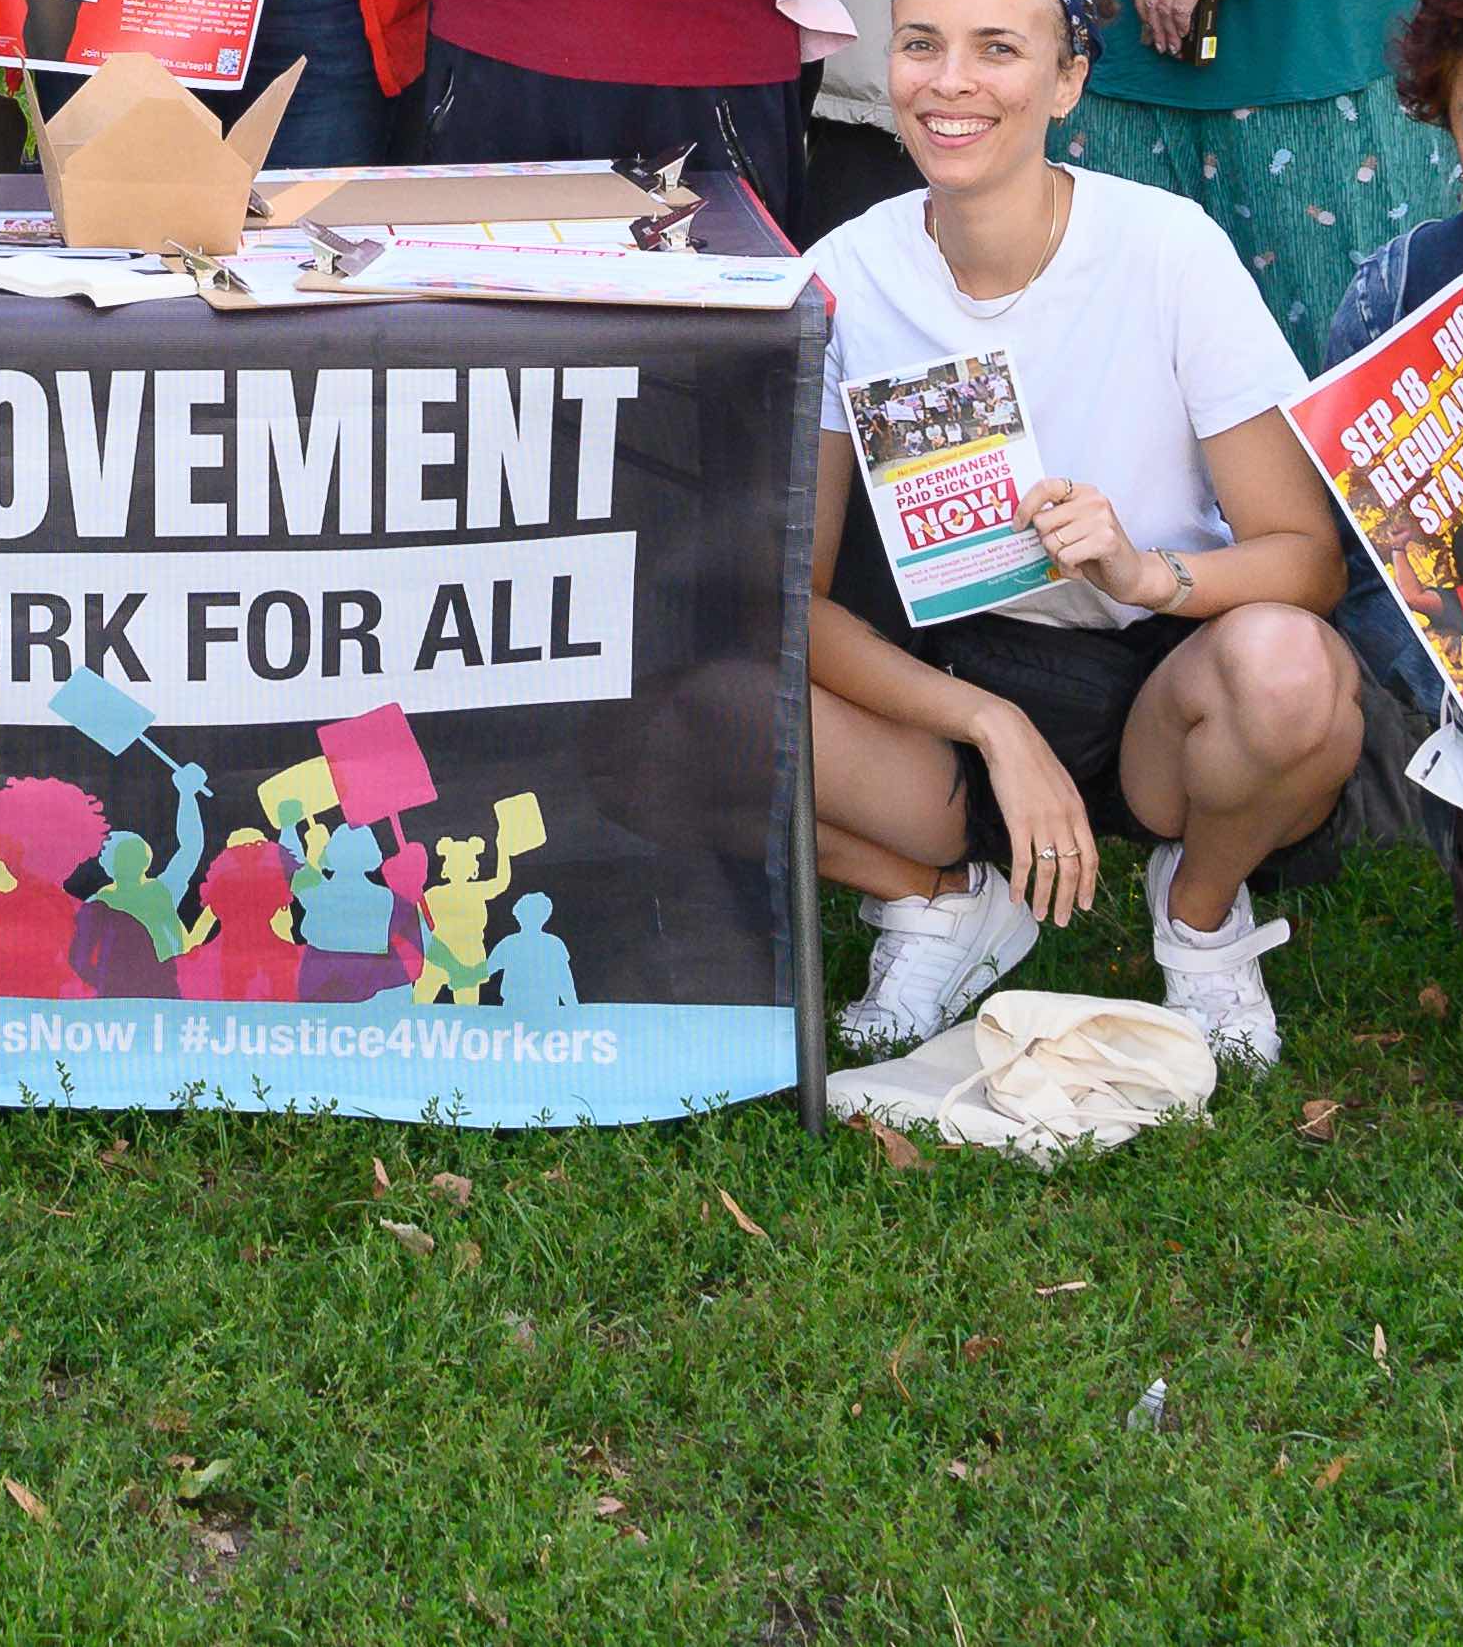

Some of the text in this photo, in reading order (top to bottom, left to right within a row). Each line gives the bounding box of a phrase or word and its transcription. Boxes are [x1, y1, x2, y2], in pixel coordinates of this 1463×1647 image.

[1340, 395, 1396, 469] SEP
[1390, 363, 1428, 413] 18
[894, 482, 912, 496] 10
[916, 449, 1007, 488] PERMANENT
[896, 463, 1011, 509] PAID SICK DAYS
[904, 480, 1012, 548] NOW
[186, 589, 382, 681] FOR
[414, 575, 602, 672] ALL
[178, 1014, 617, 1065] #Justice4Workers
